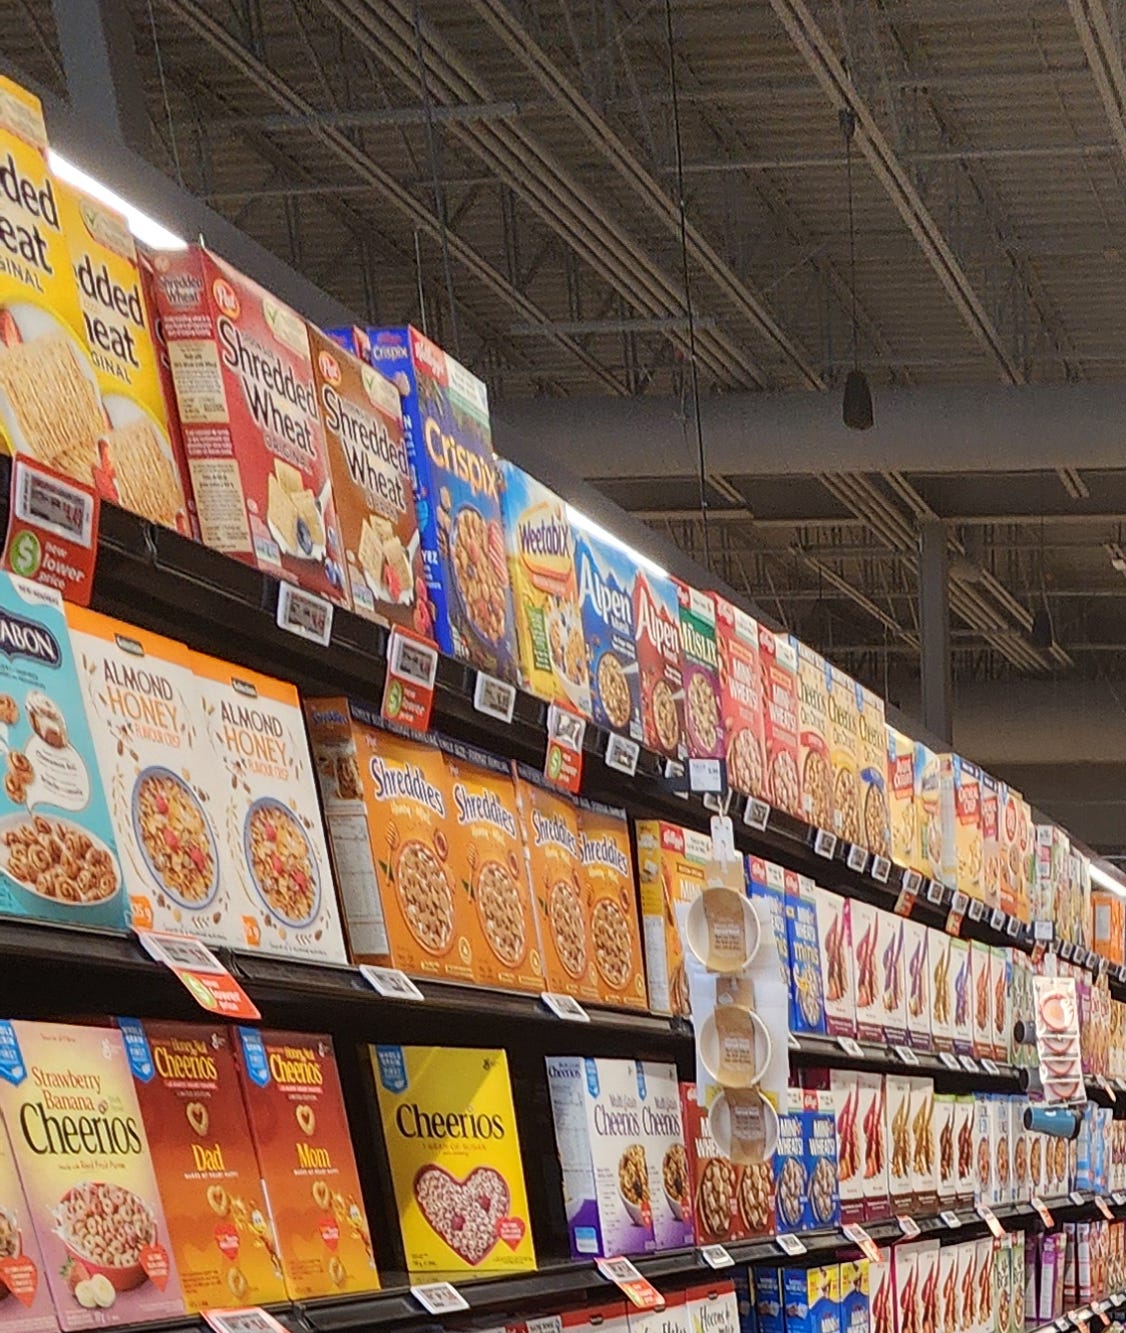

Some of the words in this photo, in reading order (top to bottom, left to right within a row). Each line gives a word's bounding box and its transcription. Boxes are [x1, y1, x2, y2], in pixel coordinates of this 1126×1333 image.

[218, 317, 318, 422] Shredded
[373, 345, 408, 361] Crispix
[244, 378, 315, 458] Wheat
[324, 385, 408, 477] Shredded
[343, 440, 405, 510] Wheat
[425, 417, 498, 502] Crispix
[519, 516, 570, 558] Weetabix
[42, 554, 85, 582] lower
[578, 545, 632, 624] Alpen
[636, 585, 681, 653] Alpen
[104, 658, 173, 701] ALMOND
[106, 686, 178, 732] HONEY
[221, 700, 283, 737] ALMOND
[223, 725, 287, 767] HONEY
[370, 755, 446, 819] Shreddies
[452, 783, 518, 840] Shreddies
[532, 807, 579, 858] Shreddies
[578, 832, 629, 878] Shreddies
[31, 1067, 102, 1094] Strawberry
[154, 1047, 218, 1080] Cheerios
[269, 1053, 324, 1085] Cheerios
[45, 1092, 95, 1112] Banana
[396, 1103, 505, 1140] Cheerios
[594, 1106, 641, 1138] Cheerios
[642, 1106, 682, 1138] Cheerios
[20, 1102, 142, 1156] Cheerios
[191, 1143, 225, 1172] Dad
[296, 1143, 332, 1169] Mom
